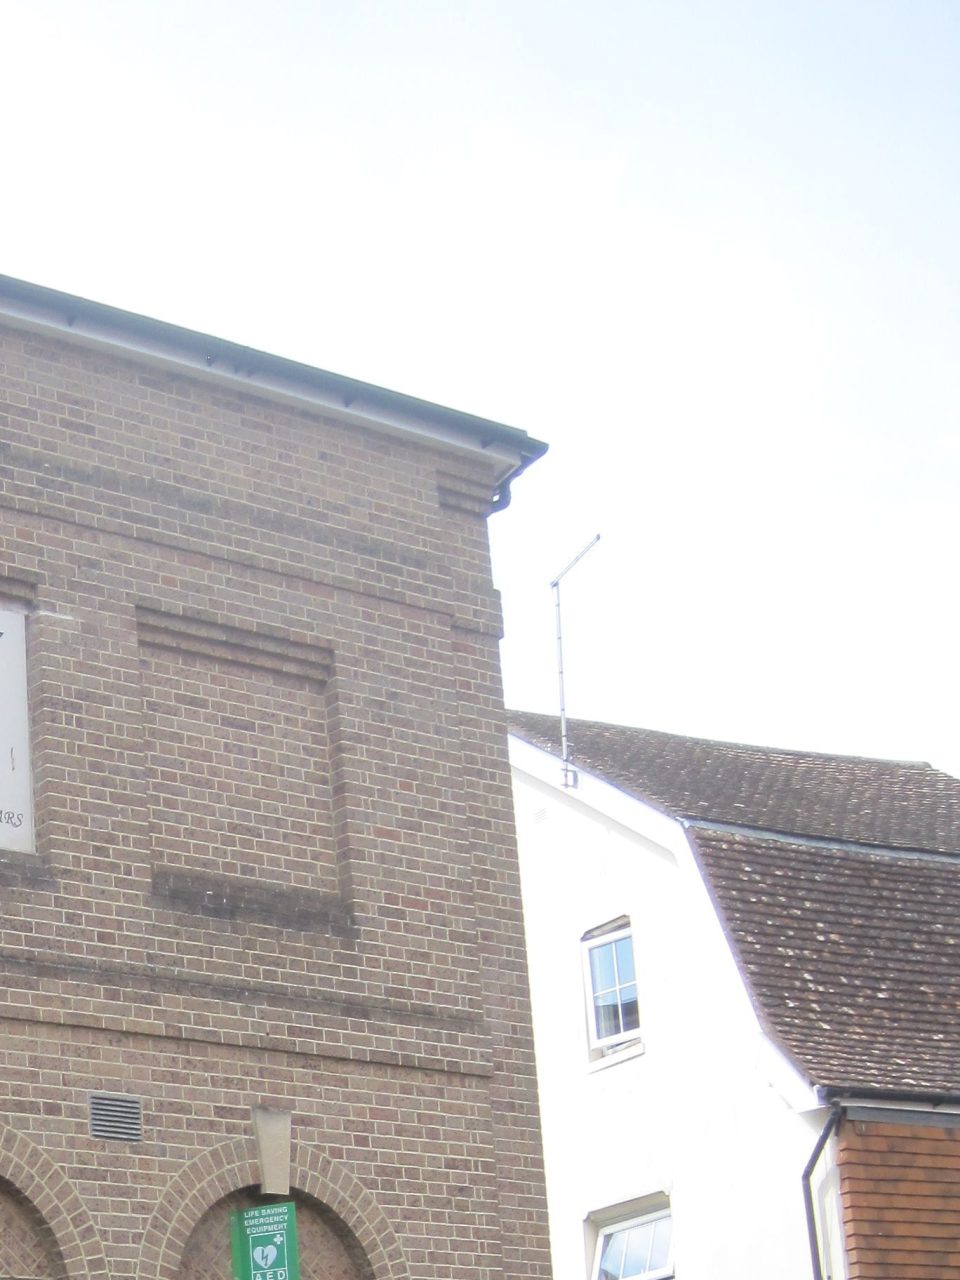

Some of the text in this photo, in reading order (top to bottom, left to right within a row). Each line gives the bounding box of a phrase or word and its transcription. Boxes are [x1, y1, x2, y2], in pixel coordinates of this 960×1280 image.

[244, 1207, 288, 1218] LIFE SAVING
[244, 1214, 289, 1227] EMERGENCY
[246, 1223, 288, 1234] EQUIPMENT
